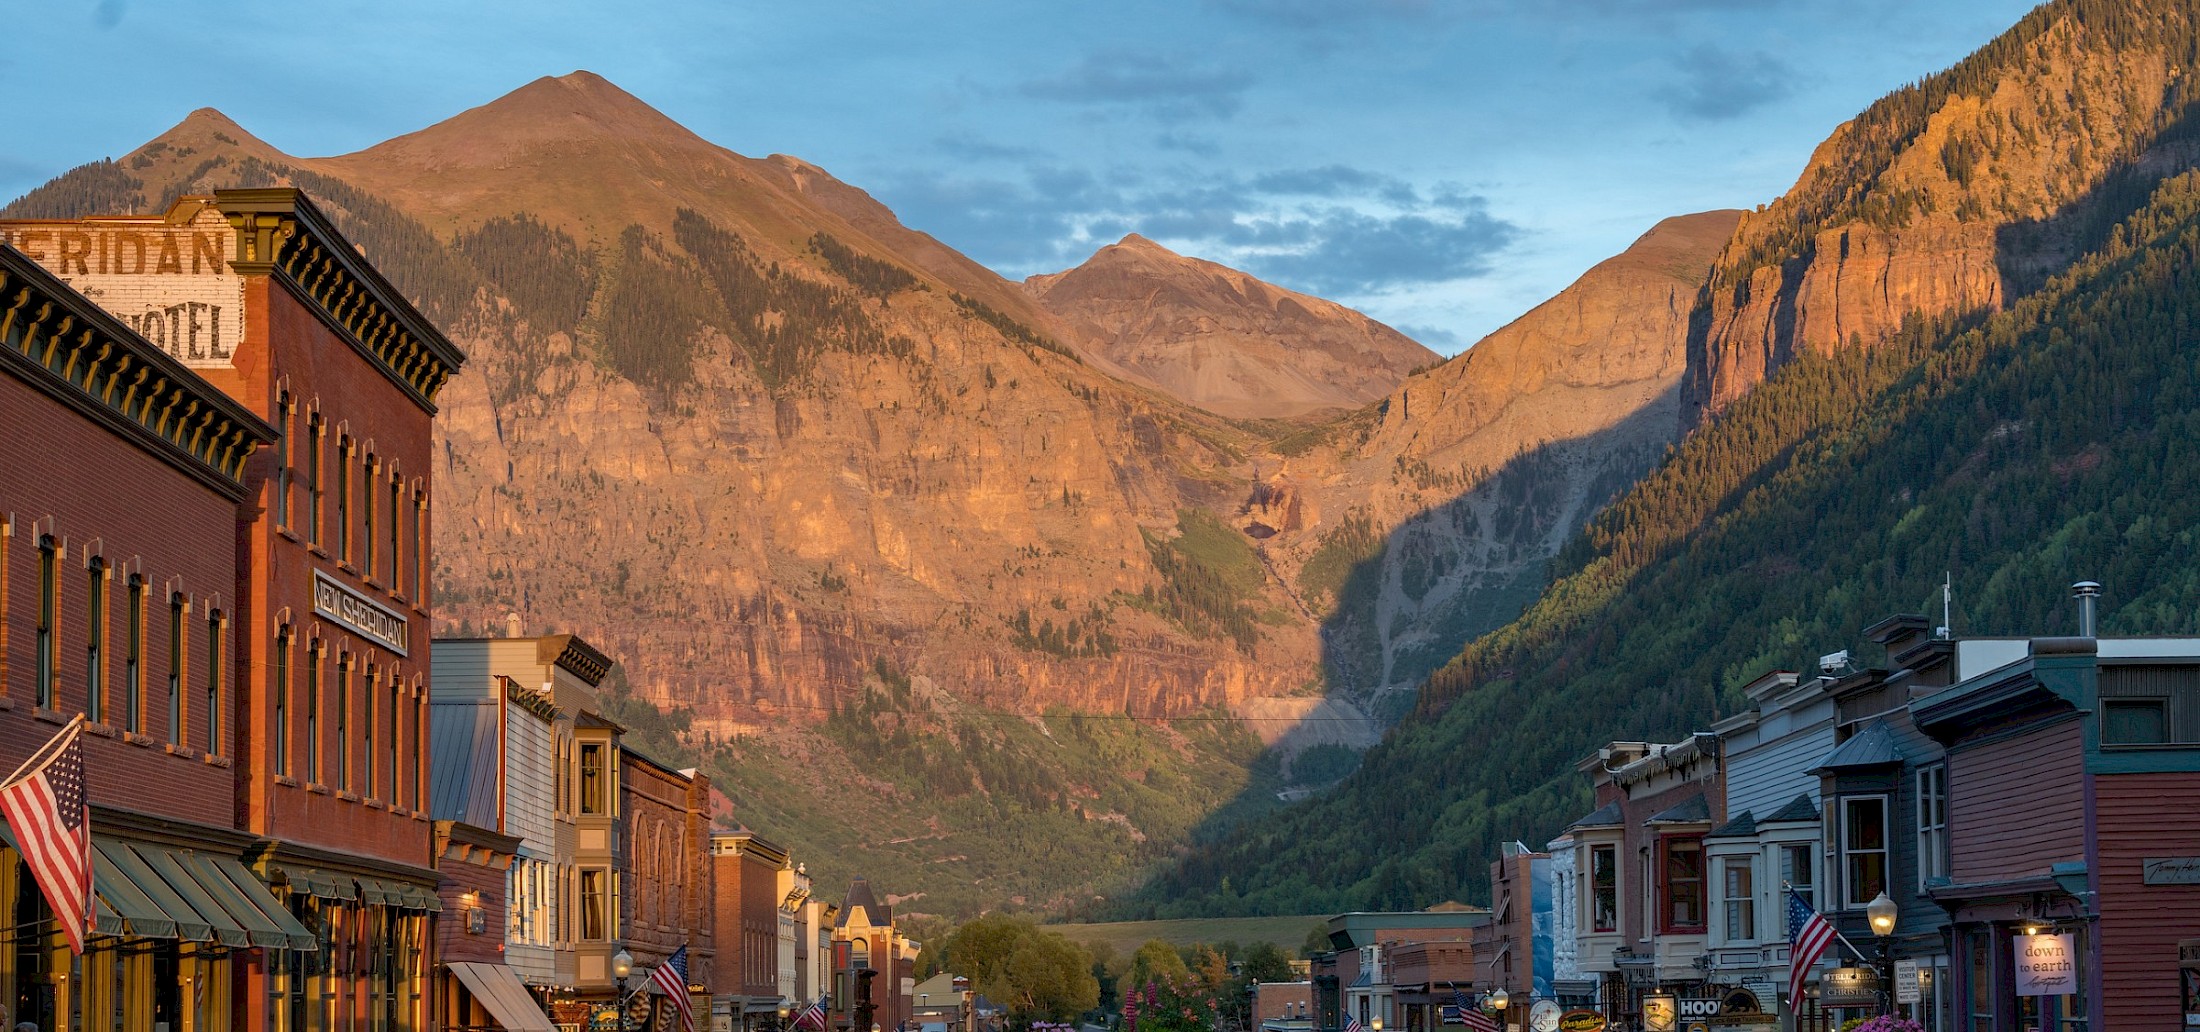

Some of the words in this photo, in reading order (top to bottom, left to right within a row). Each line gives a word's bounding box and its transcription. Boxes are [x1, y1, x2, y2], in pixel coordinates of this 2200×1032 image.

[4, 231, 225, 275] ERIDAN
[315, 575, 341, 616] NEW
[343, 594, 402, 648] SHERIDAN
[2025, 945, 2065, 957] down
[2020, 964, 2030, 973] to
[2033, 960, 2071, 972] earth
[1680, 1001, 1720, 1015] HOO
[1561, 1015, 1604, 1029] Paradise
